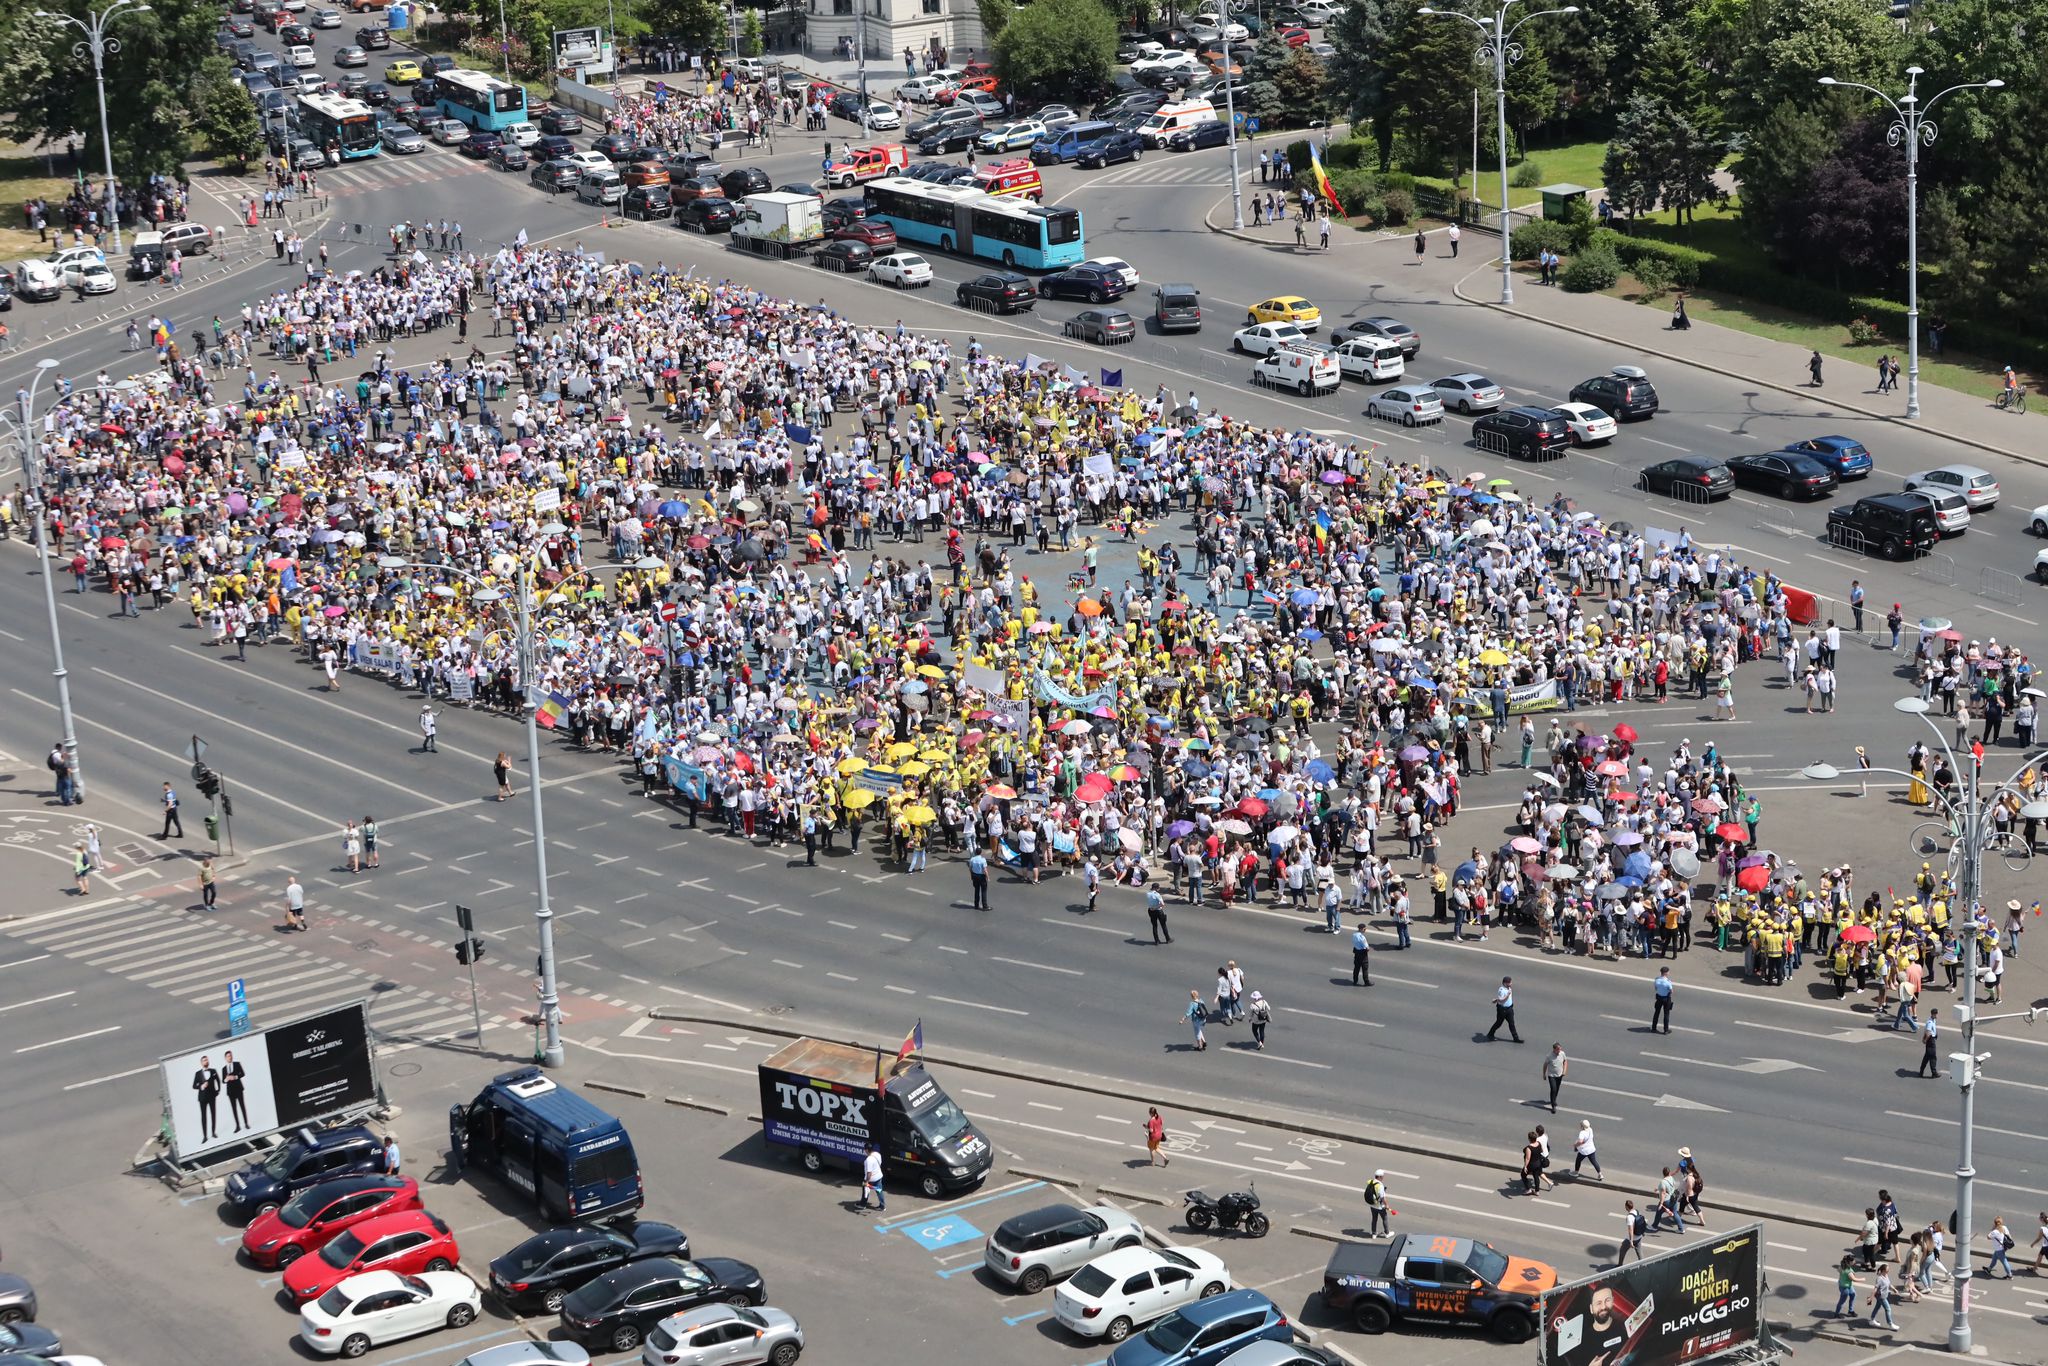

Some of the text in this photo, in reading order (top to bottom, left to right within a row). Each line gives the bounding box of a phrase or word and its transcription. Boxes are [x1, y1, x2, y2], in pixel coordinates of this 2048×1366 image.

[231, 981, 240, 1001] P
[776, 1082, 867, 1125] TOPX
[772, 1128, 791, 1139] UNIM
[800, 1135, 835, 1149] MILIOANE
[790, 1125, 809, 1135] Digital
[579, 1135, 620, 1153] JANDARMERIA
[956, 1137, 984, 1159] TOPX
[1349, 1279, 1364, 1287] MIT
[1681, 1263, 1715, 1293] JOACĂ
[1693, 1279, 1739, 1305] POKER pe
[1416, 1300, 1465, 1313] HVAC
